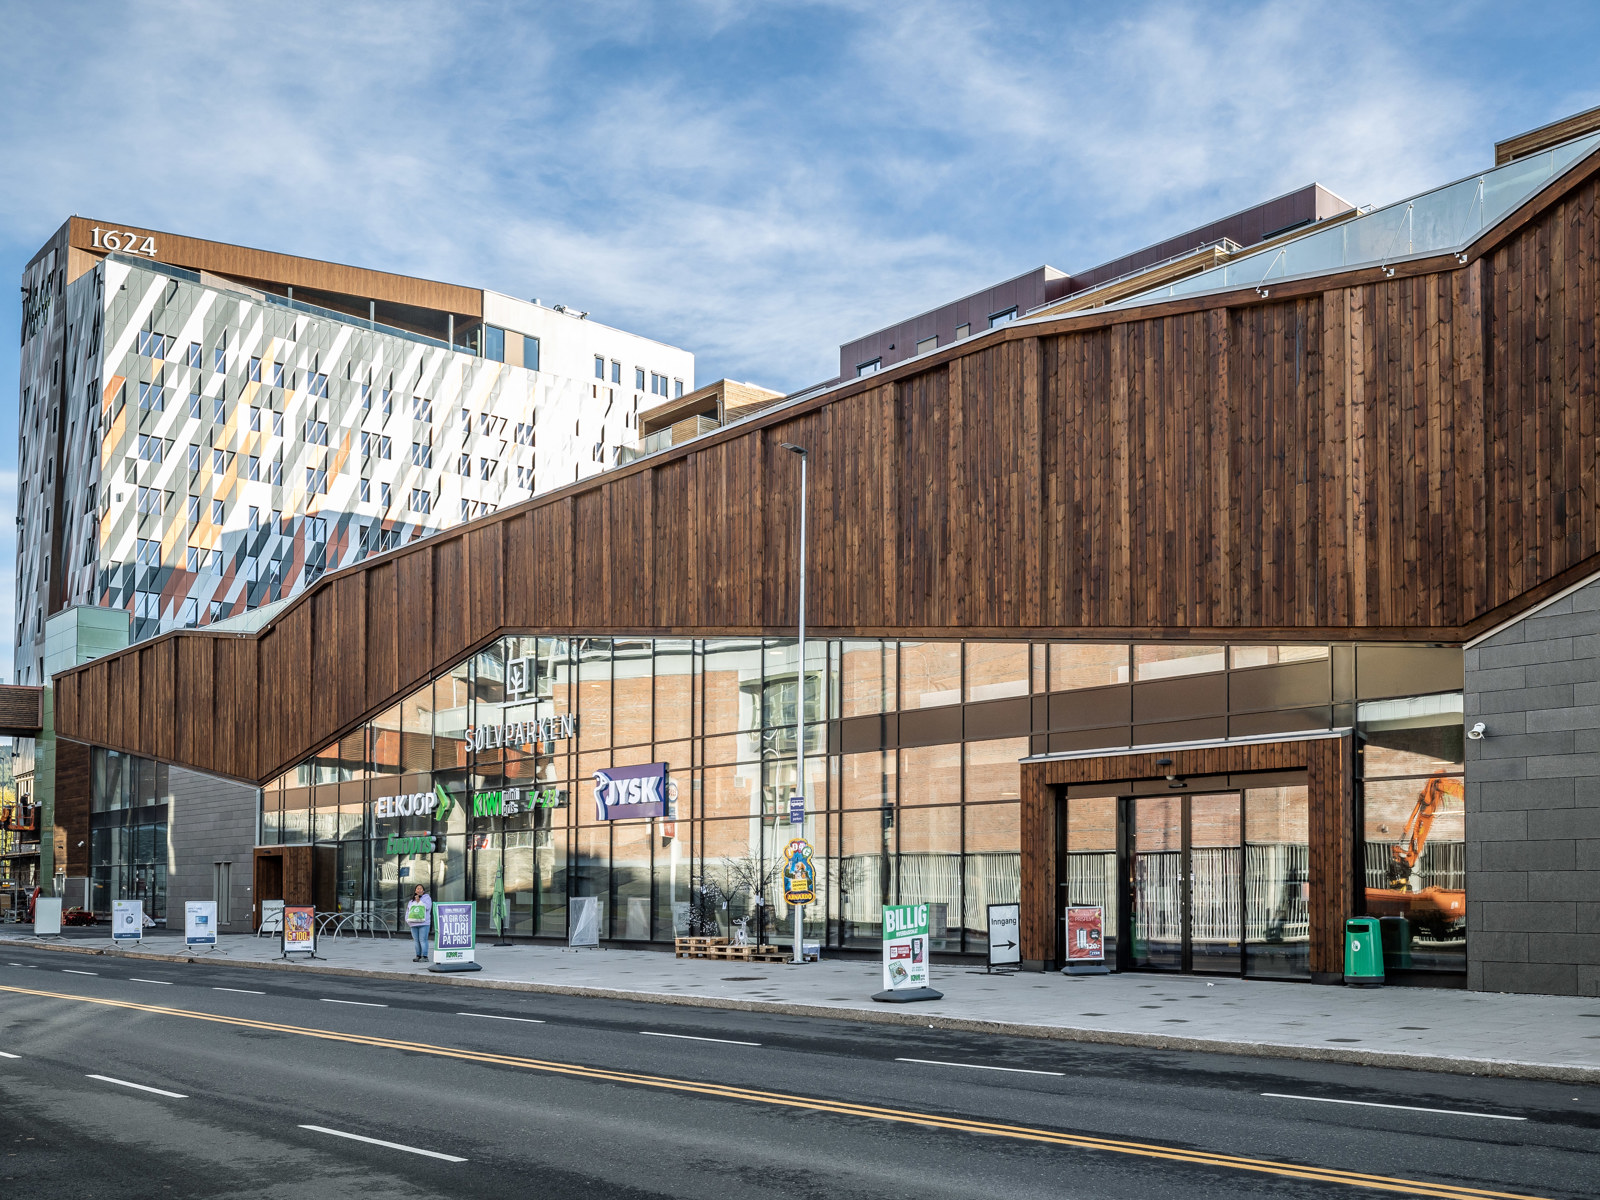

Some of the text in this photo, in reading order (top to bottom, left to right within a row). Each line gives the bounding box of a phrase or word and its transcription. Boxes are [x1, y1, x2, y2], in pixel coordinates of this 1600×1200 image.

[90, 226, 158, 257] 1624
[464, 713, 575, 754] SØLVPARKEN
[473, 791, 503, 818] KIWI
[605, 776, 663, 806] JYSK
[377, 792, 436, 819] ELKJØP
[386, 832, 434, 859] Europris
[443, 922, 469, 936] ALDRI
[449, 914, 458, 923] GIR
[459, 914, 469, 922] OSS
[885, 905, 928, 933] BILLIG
[991, 918, 1017, 927] Inngang
[288, 931, 293, 941] 5
